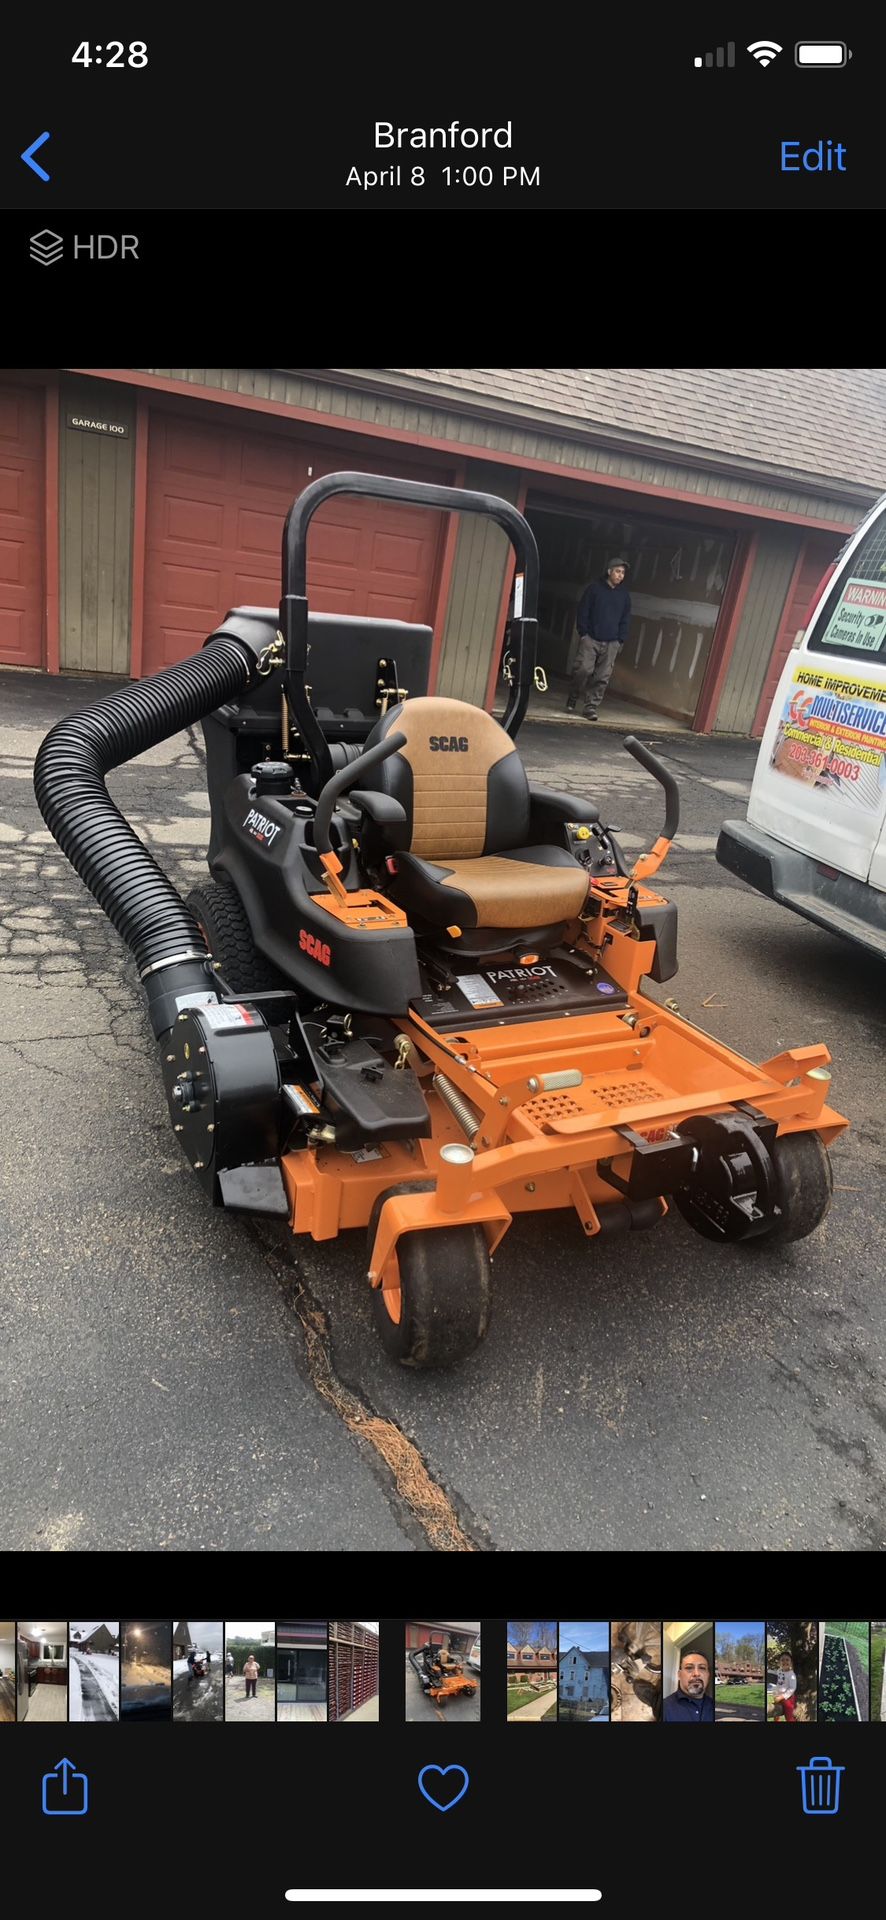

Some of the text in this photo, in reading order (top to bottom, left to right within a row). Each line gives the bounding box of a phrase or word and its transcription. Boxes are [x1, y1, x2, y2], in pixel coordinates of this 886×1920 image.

[72, 418, 108, 431] GARAGE
[838, 607, 866, 628] Security
[830, 624, 876, 647] Cameras In Use
[797, 672, 824, 687] HOME
[429, 736, 469, 752] SCAG
[783, 723, 882, 768] Commercial & Residential
[789, 743, 860, 781] 203-361-0003
[242, 809, 281, 846] PATRIOT
[299, 929, 331, 967] SCAG
[486, 966, 558, 984] PATRIOT
